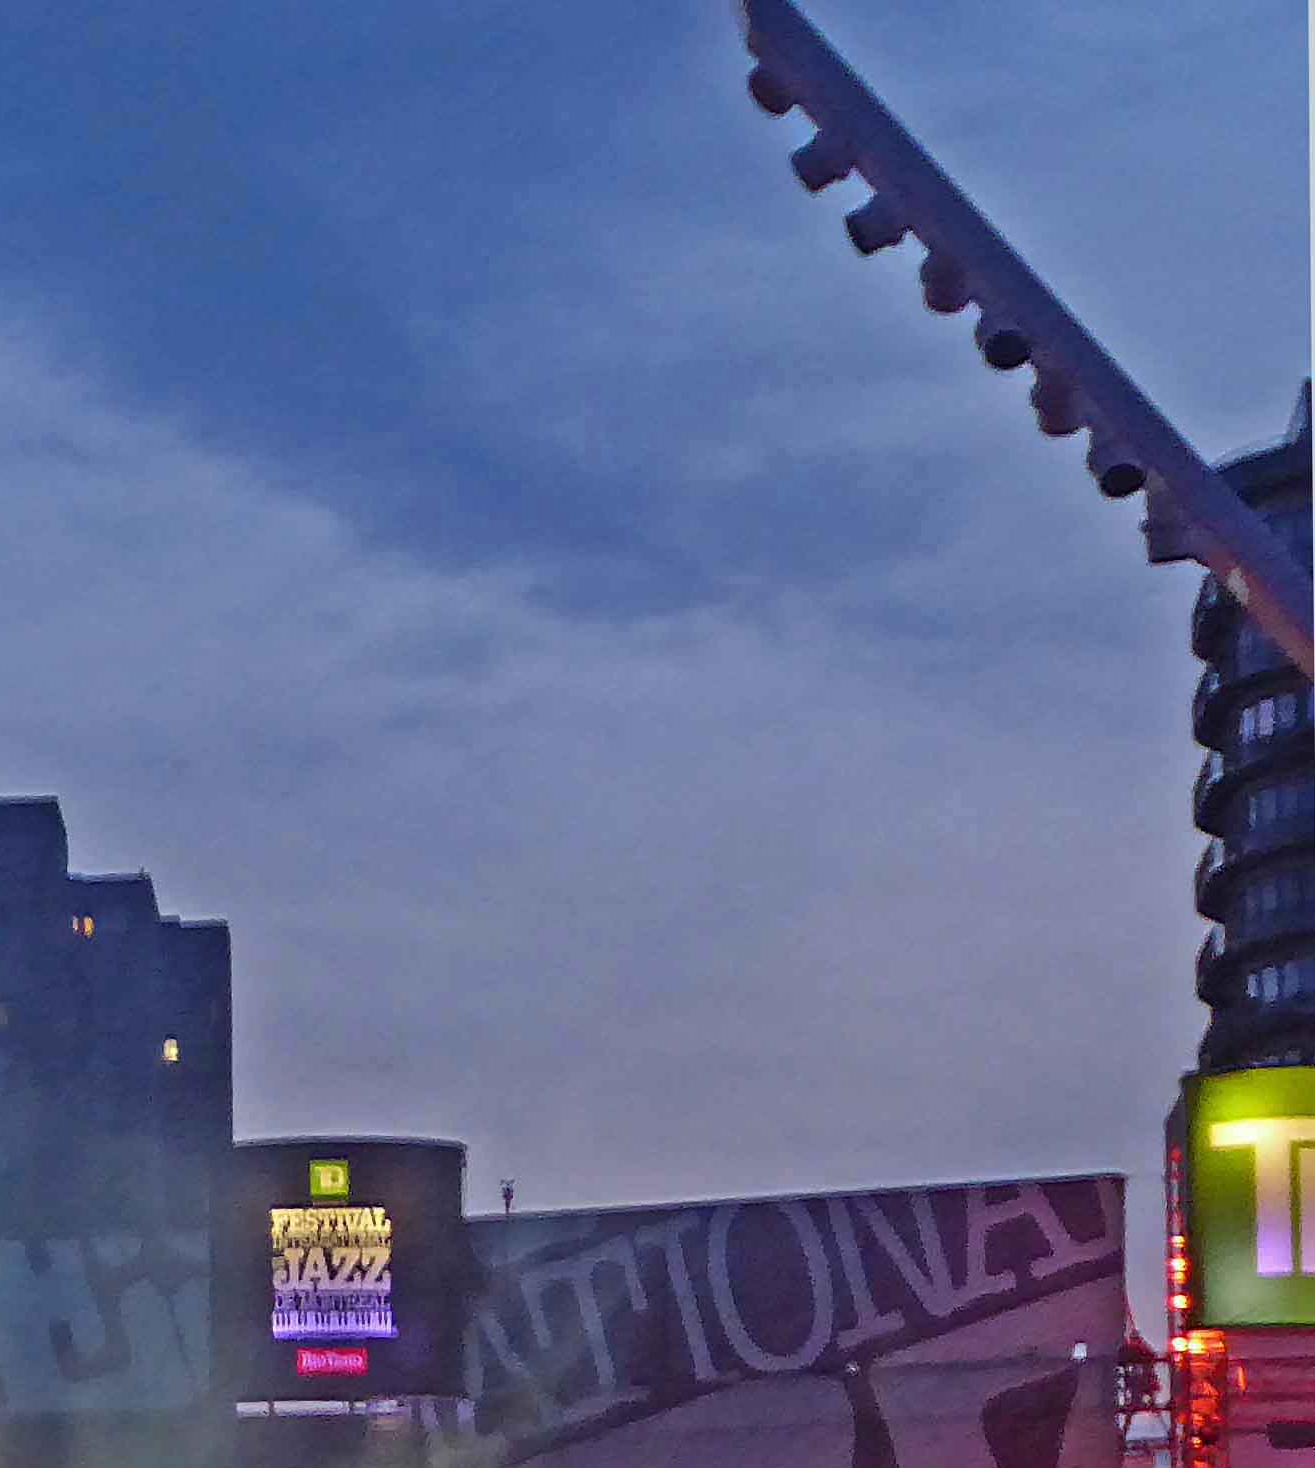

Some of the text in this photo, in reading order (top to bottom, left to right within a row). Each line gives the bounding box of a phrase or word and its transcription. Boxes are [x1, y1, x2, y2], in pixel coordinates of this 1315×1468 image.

[1209, 1115, 1312, 1276] T
[270, 1206, 391, 1236] FESTIVAL
[272, 1247, 391, 1291] JAZZ
